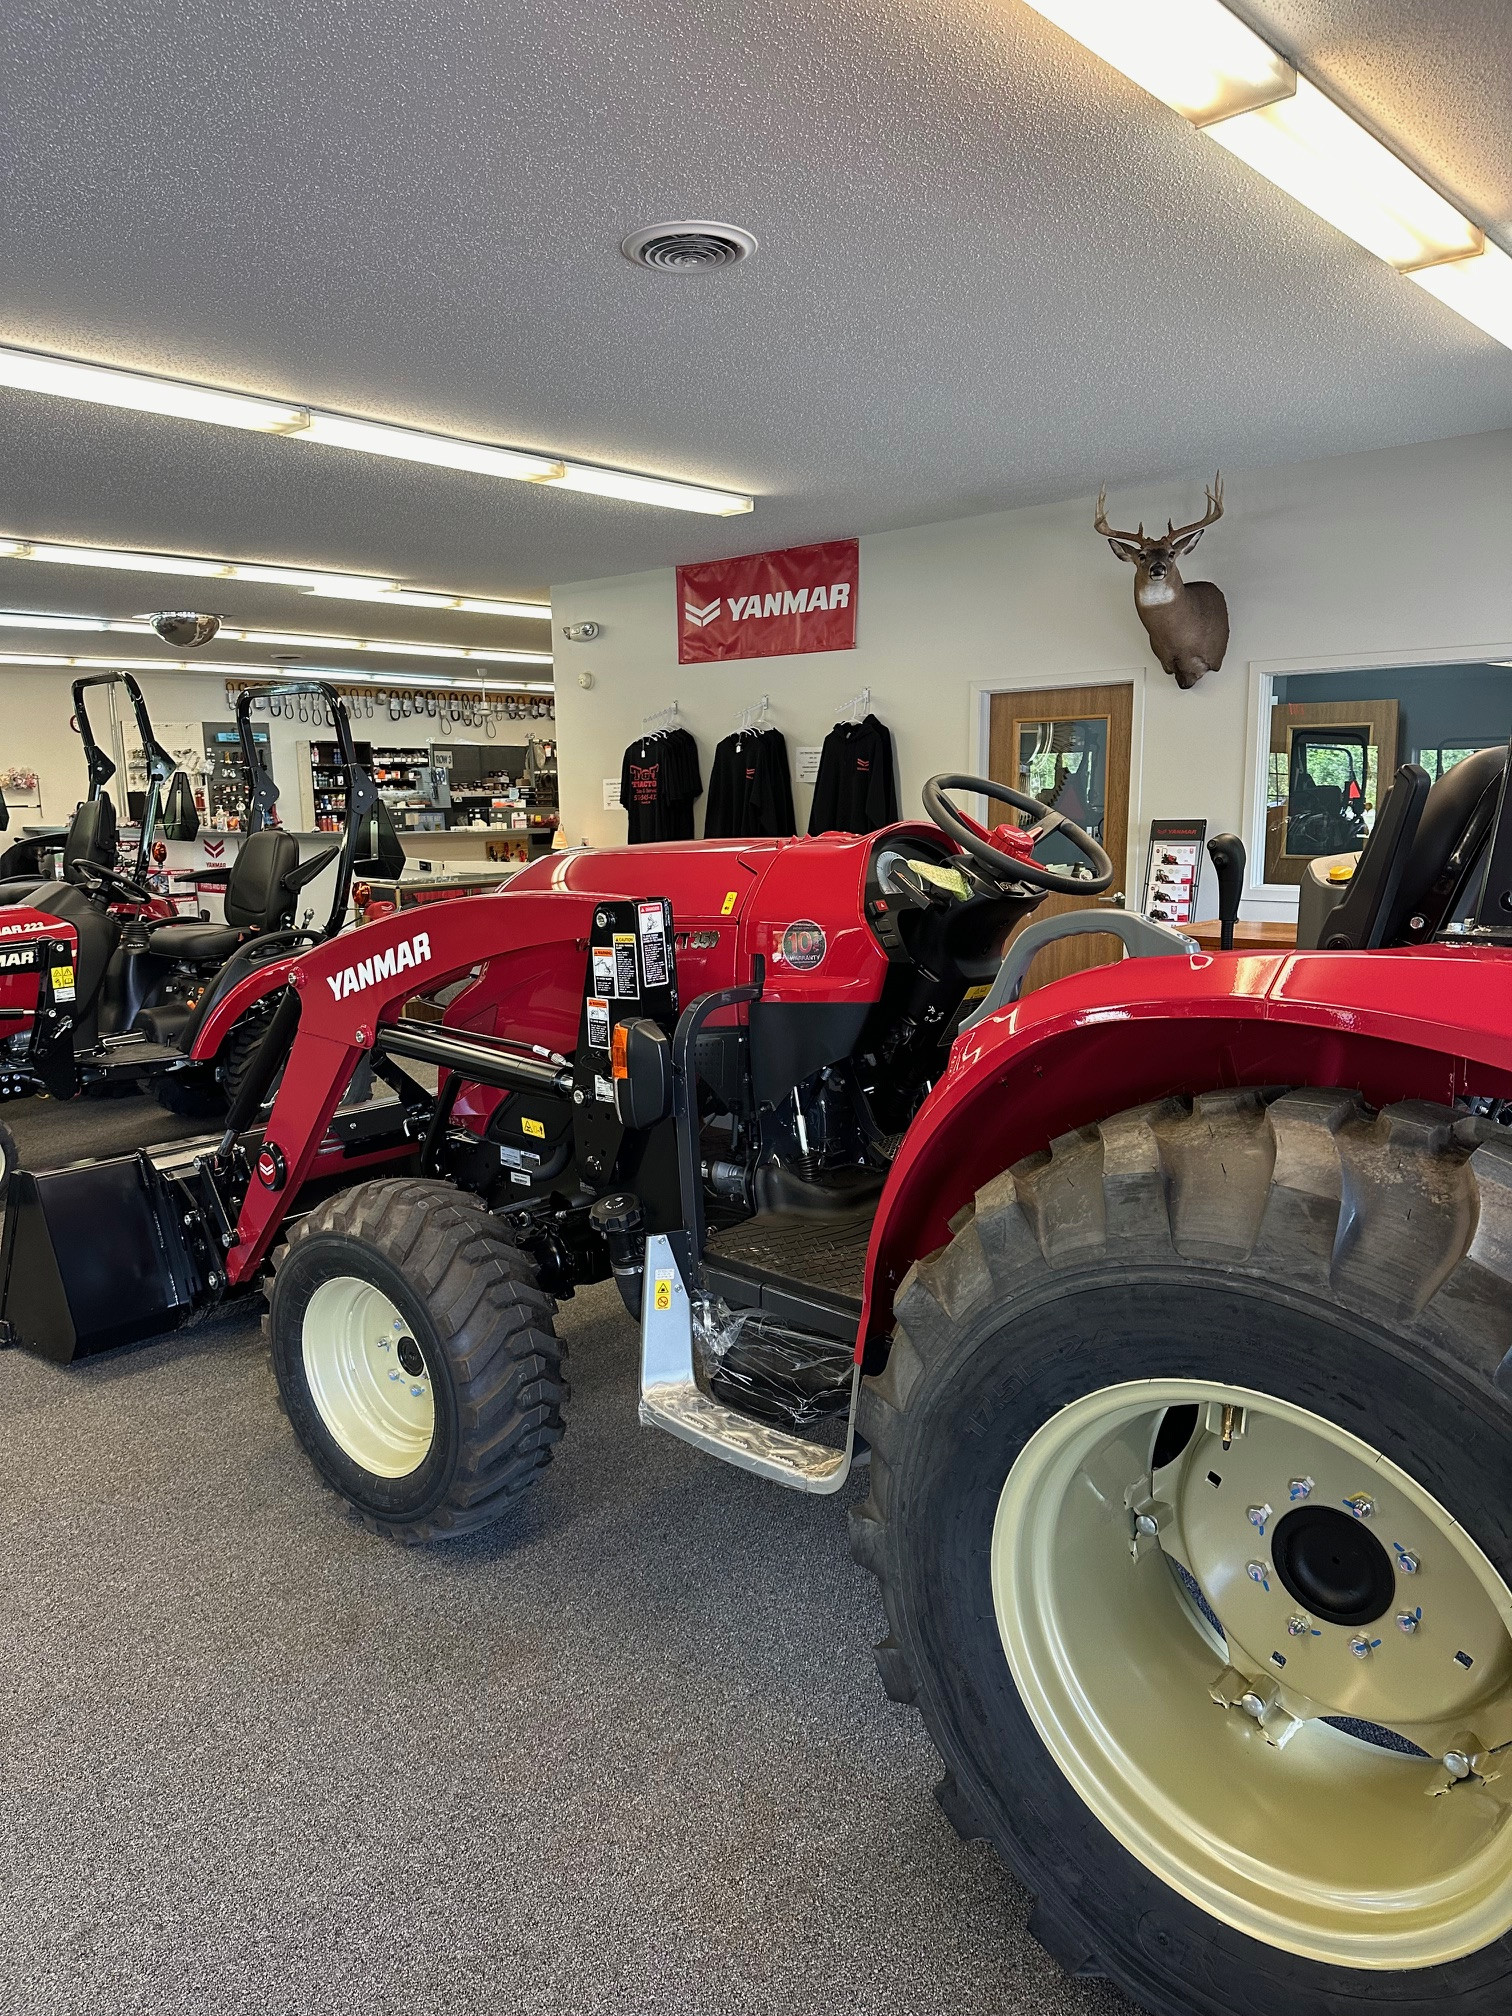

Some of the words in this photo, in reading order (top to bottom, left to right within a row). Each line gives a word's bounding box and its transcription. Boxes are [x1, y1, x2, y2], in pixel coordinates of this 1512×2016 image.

[727, 583, 851, 622] YANMAR
[435, 754, 447, 764] ROW
[448, 755, 452, 764] 3
[24, 922, 44, 932] 223
[787, 931, 813, 954] 10
[326, 932, 432, 1002] YANMAR
